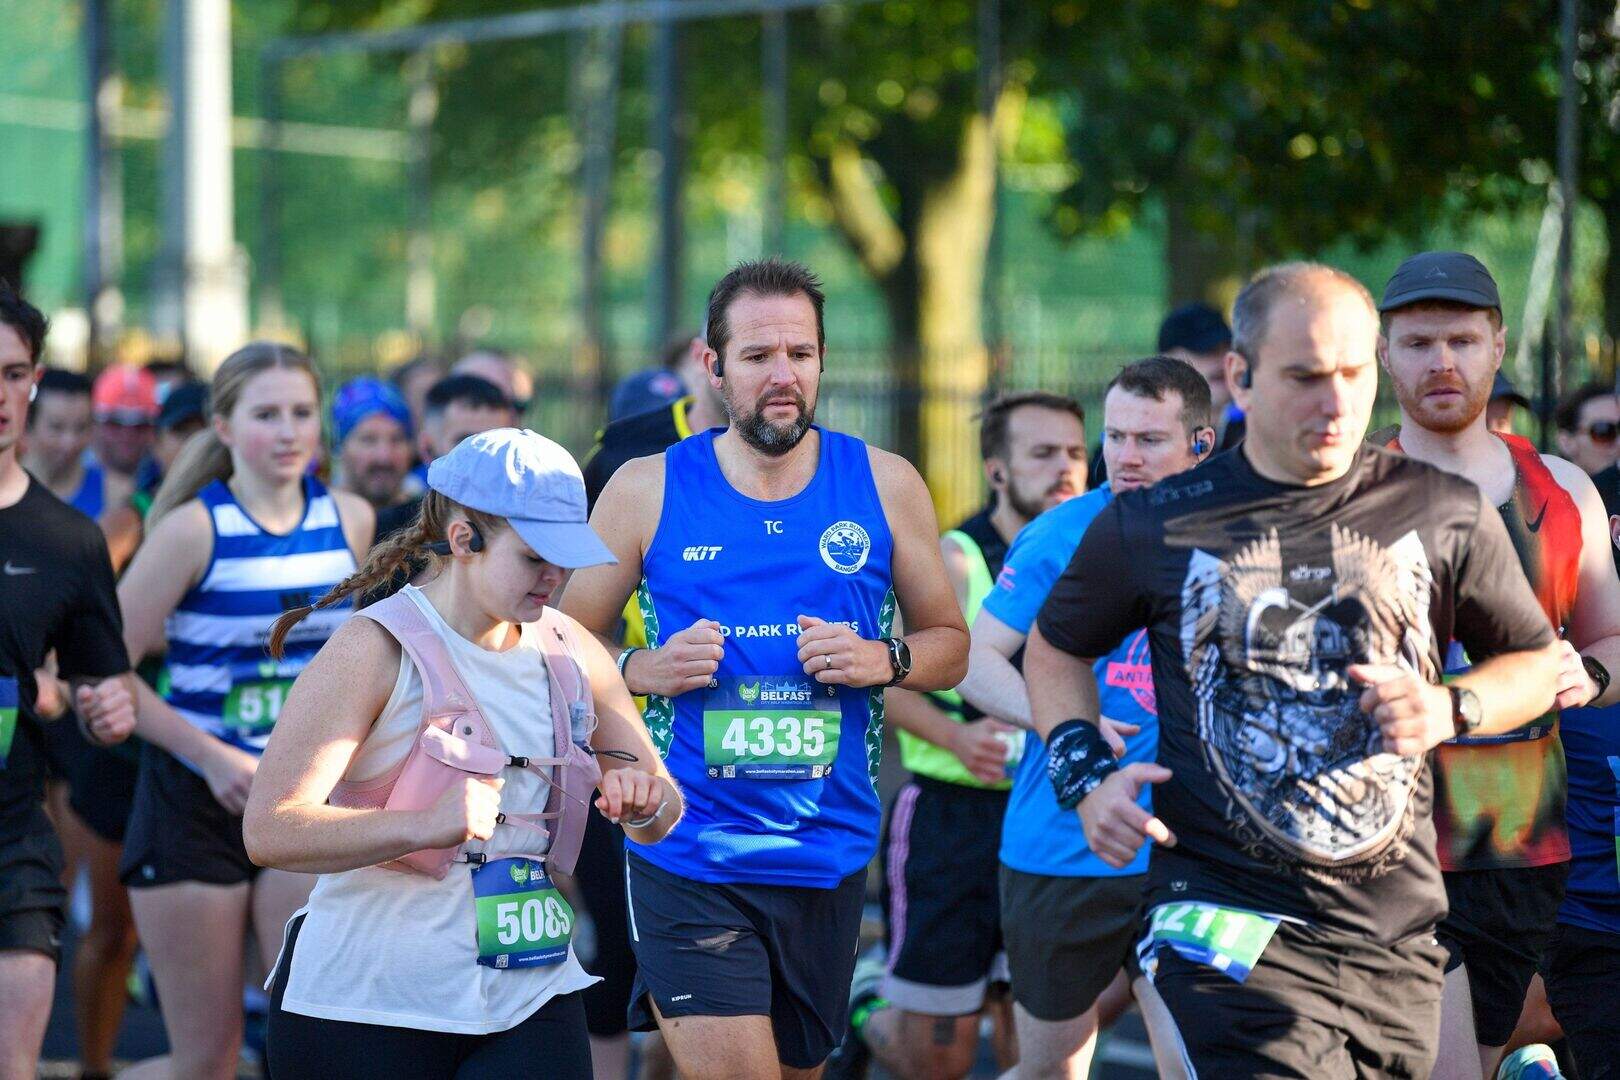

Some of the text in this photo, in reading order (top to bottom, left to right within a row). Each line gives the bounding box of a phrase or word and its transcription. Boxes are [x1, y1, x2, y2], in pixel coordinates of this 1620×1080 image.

[764, 520, 784, 535] TC
[821, 531, 832, 549] WARD
[830, 522, 848, 532] PARK
[735, 623, 782, 638] PARK
[761, 691, 812, 701] BELFAST
[721, 717, 825, 757] 4335
[497, 896, 571, 945] 5083
